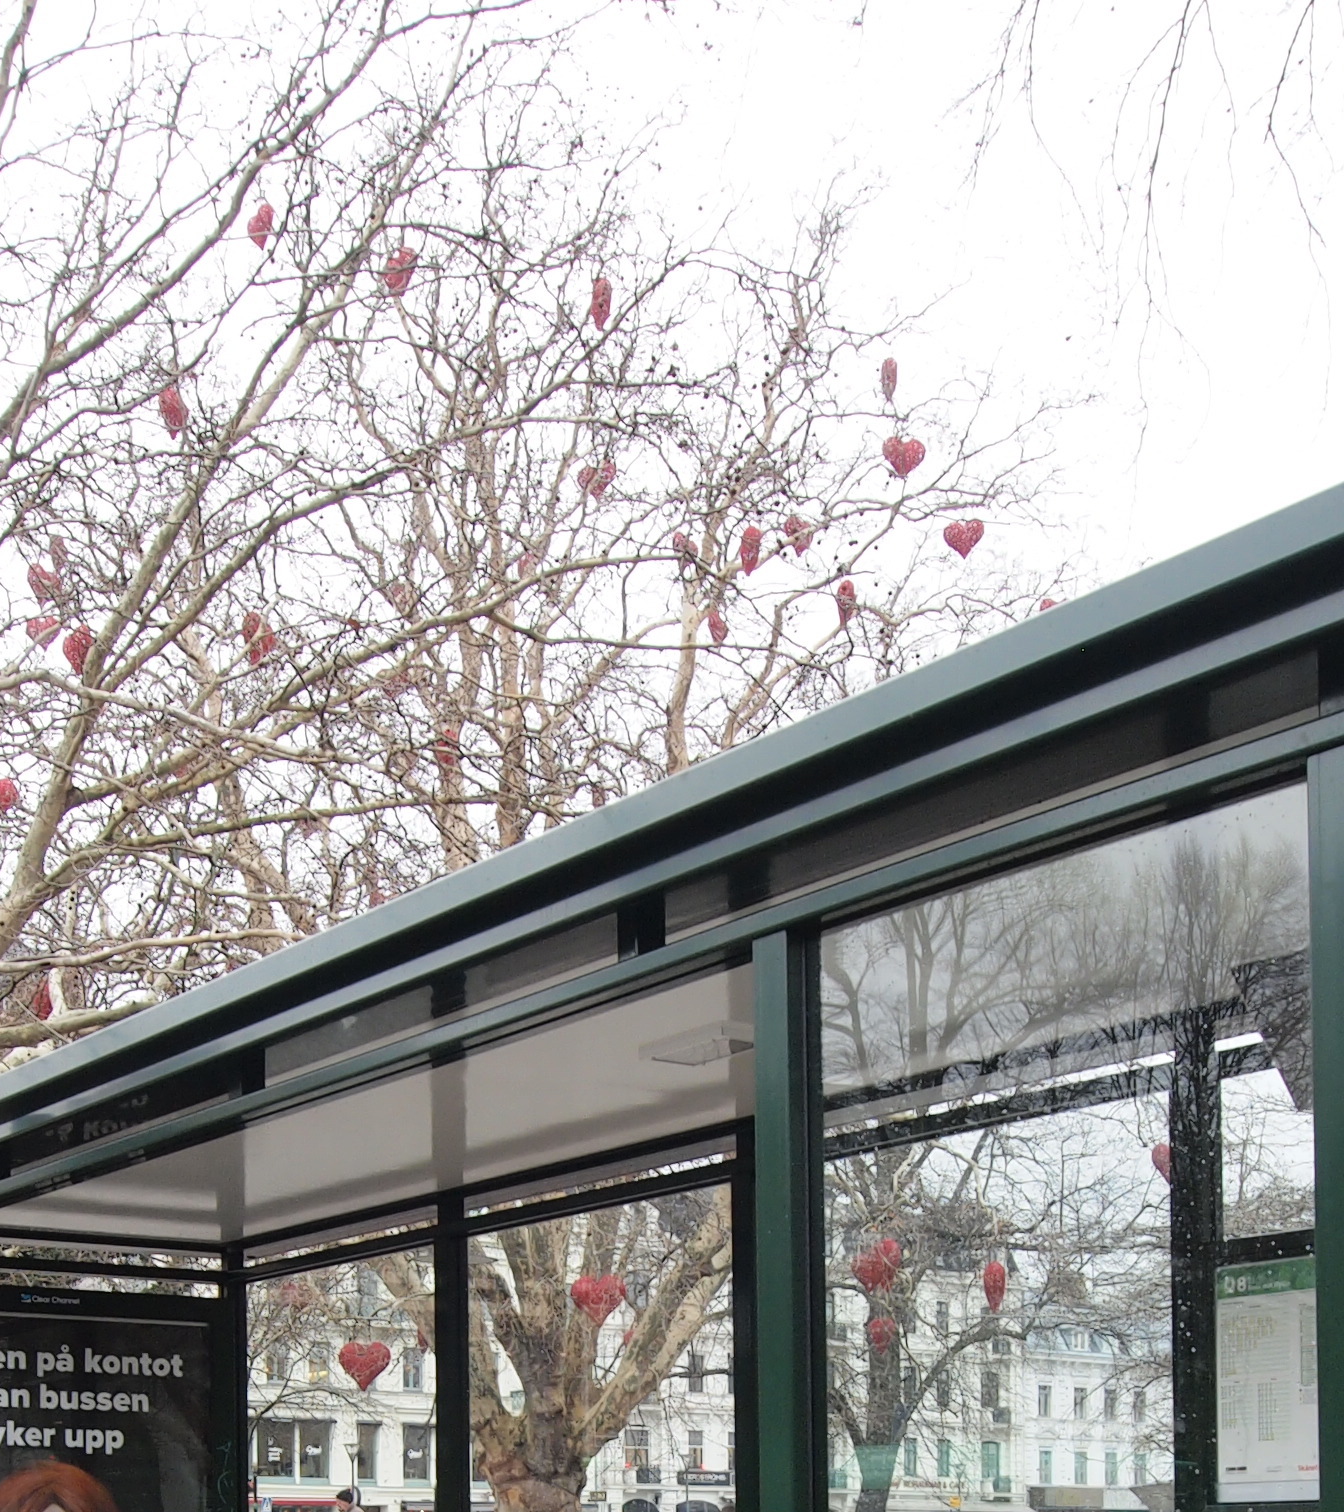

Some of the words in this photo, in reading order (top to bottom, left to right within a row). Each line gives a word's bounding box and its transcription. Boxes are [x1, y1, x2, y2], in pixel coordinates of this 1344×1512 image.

[36, 1345, 74, 1377] på
[85, 1348, 184, 1378] kontot
[40, 1384, 149, 1413] bussen
[65, 1428, 124, 1455] upp
